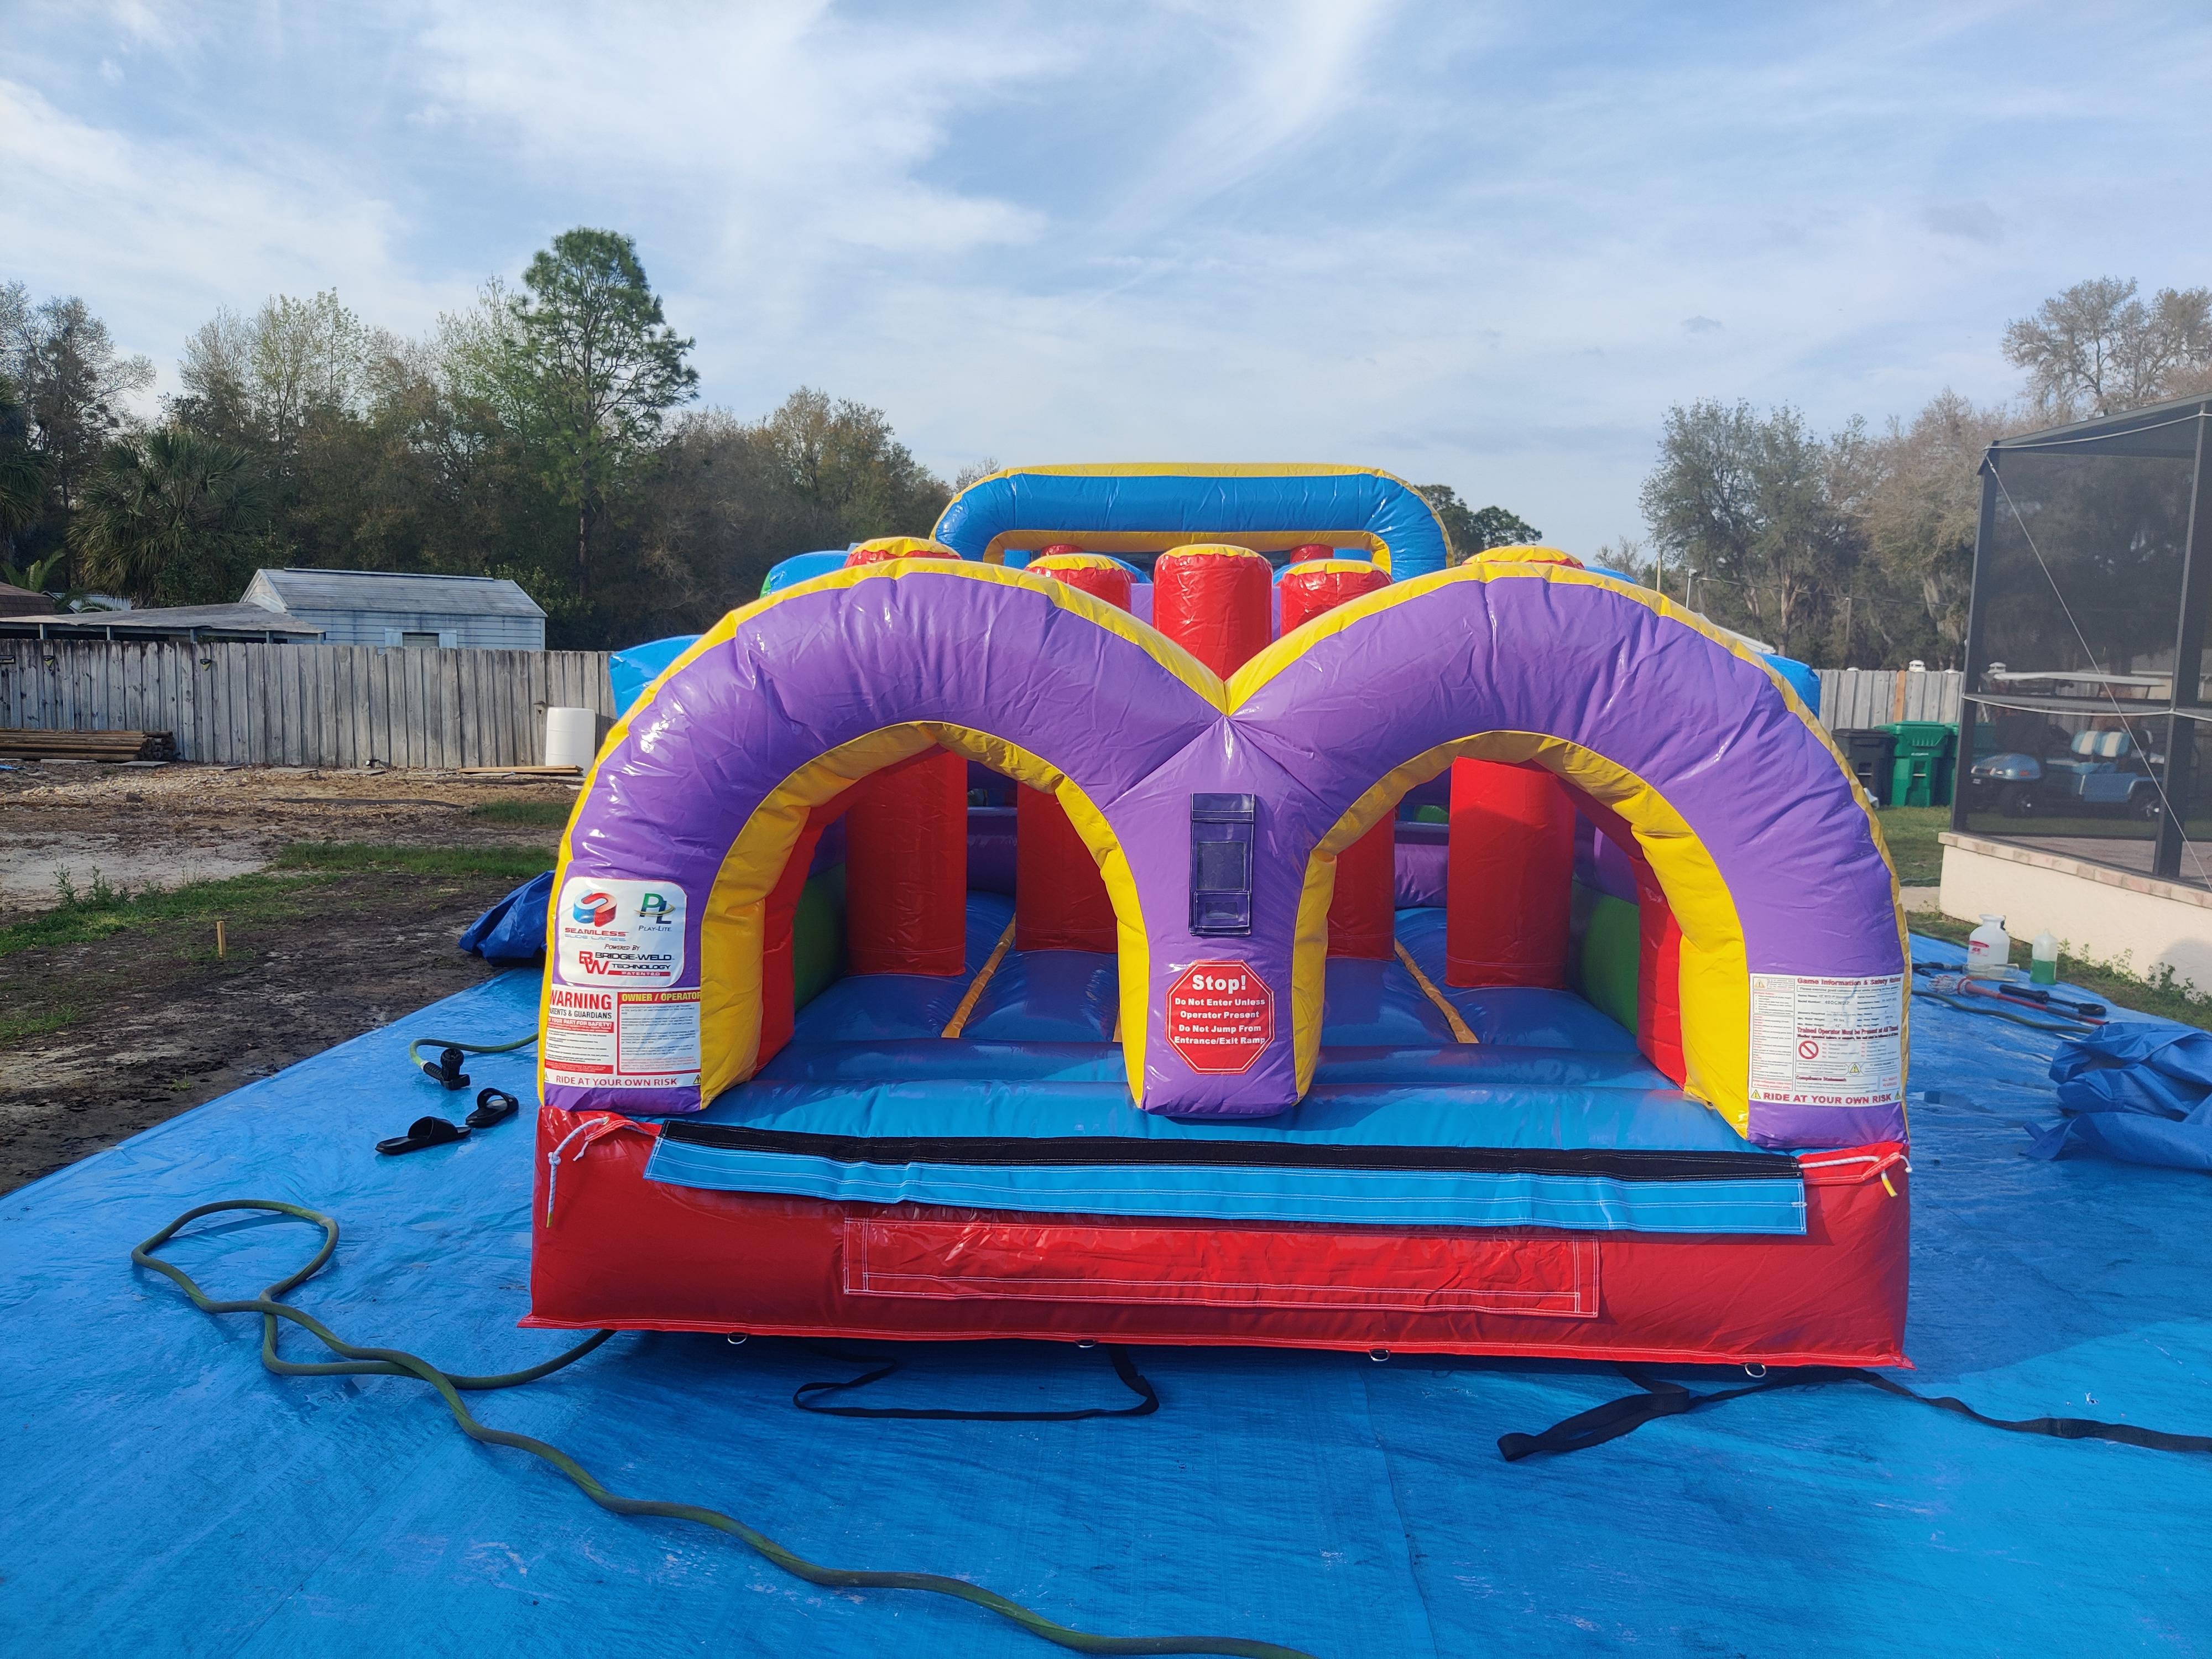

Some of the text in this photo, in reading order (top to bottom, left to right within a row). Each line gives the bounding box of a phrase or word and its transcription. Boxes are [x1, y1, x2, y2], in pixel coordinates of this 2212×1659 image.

[565, 927, 629, 937] SEAMLESS
[595, 952, 672, 961] BRIDGE-WELD
[579, 951, 610, 975] BW
[1192, 974, 1246, 994] Stop!
[550, 989, 612, 1010] WARNING
[622, 993, 653, 1001] OWNER
[1188, 998, 1204, 1006] Not
[550, 1007, 567, 1016] ARENTS
[574, 1010, 612, 1019] GUARDIANS
[1180, 1010, 1222, 1020] Operator
[1211, 1025, 1237, 1034] Jump
[1174, 1036, 1239, 1045] Entrance/Exit
[556, 1075, 576, 1084] RIDE
[578, 1077, 589, 1086] AT
[654, 1078, 677, 1086] RISK
[1763, 1092, 1892, 1104] RIDE AT YOUR OWN RISK
